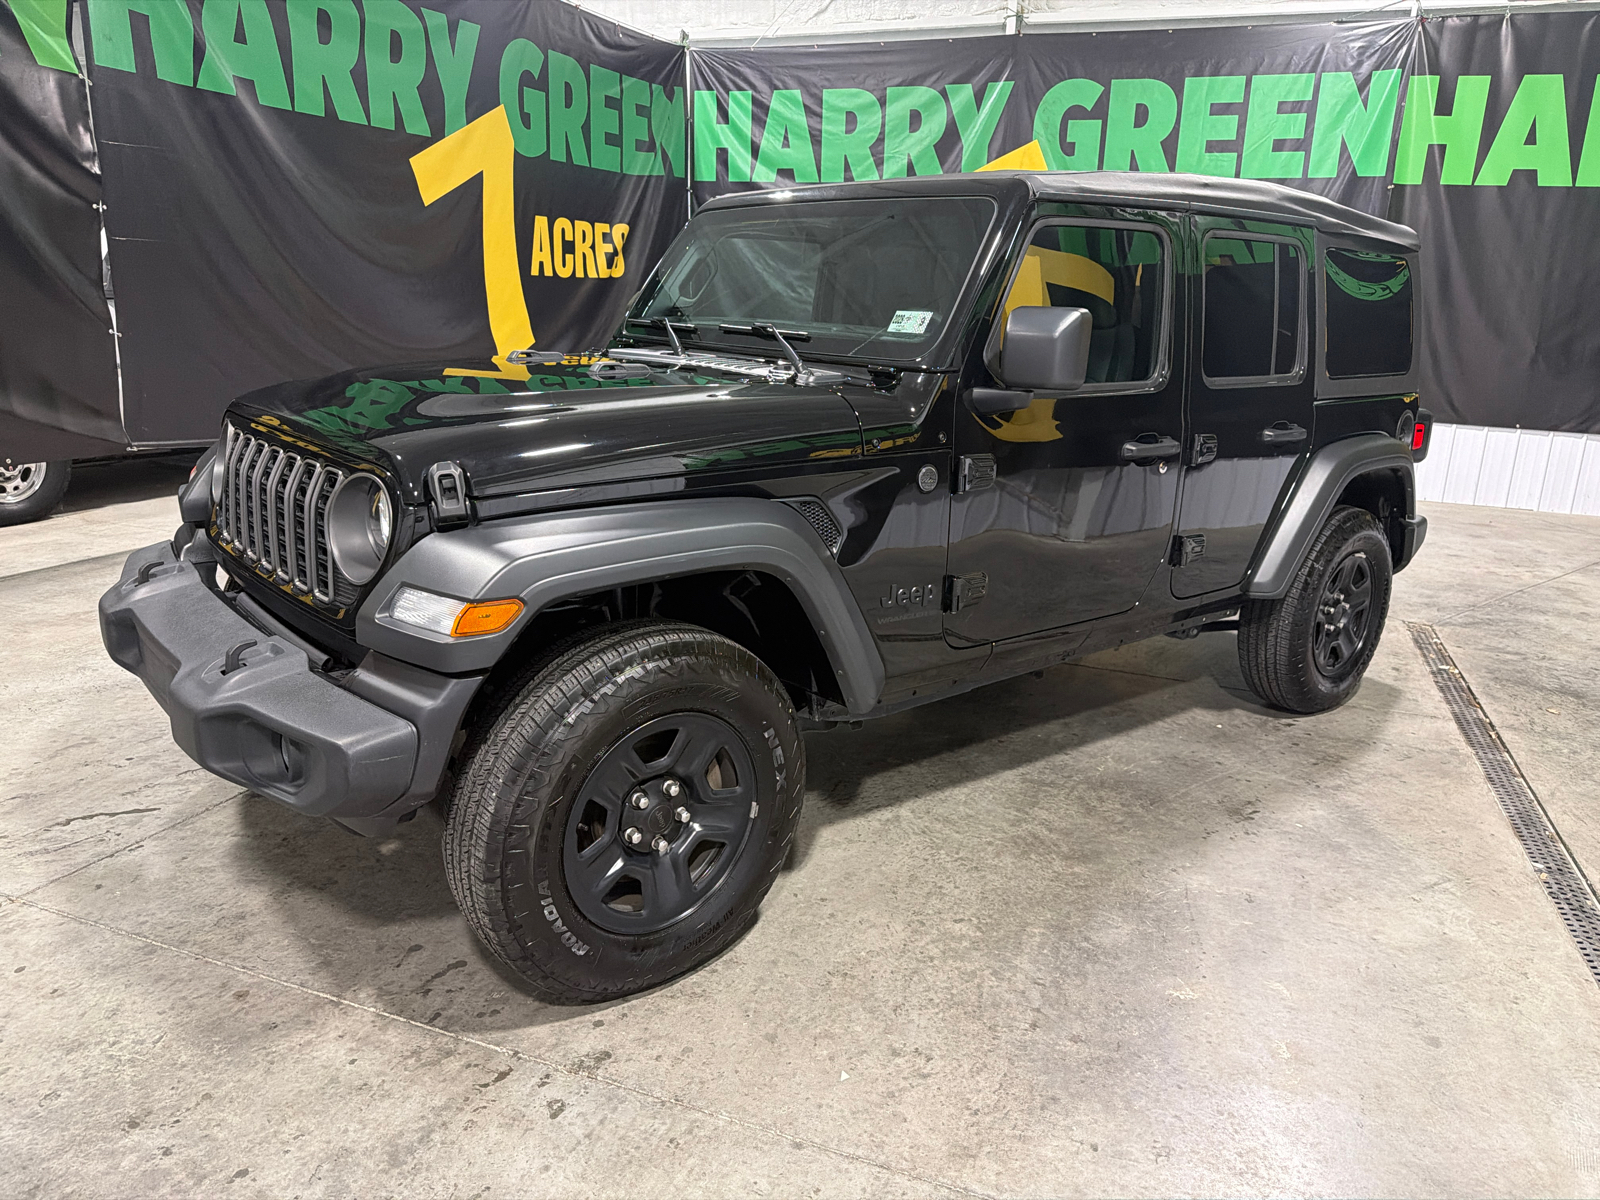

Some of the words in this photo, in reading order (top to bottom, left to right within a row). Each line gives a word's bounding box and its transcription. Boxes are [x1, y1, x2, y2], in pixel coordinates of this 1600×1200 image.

[87, 0, 481, 138] HARRY
[500, 38, 685, 178] GREEN
[694, 80, 1015, 183] HARRY
[1032, 68, 1402, 178] GREEN
[531, 215, 629, 278] ACRES
[880, 583, 937, 608] Jeep
